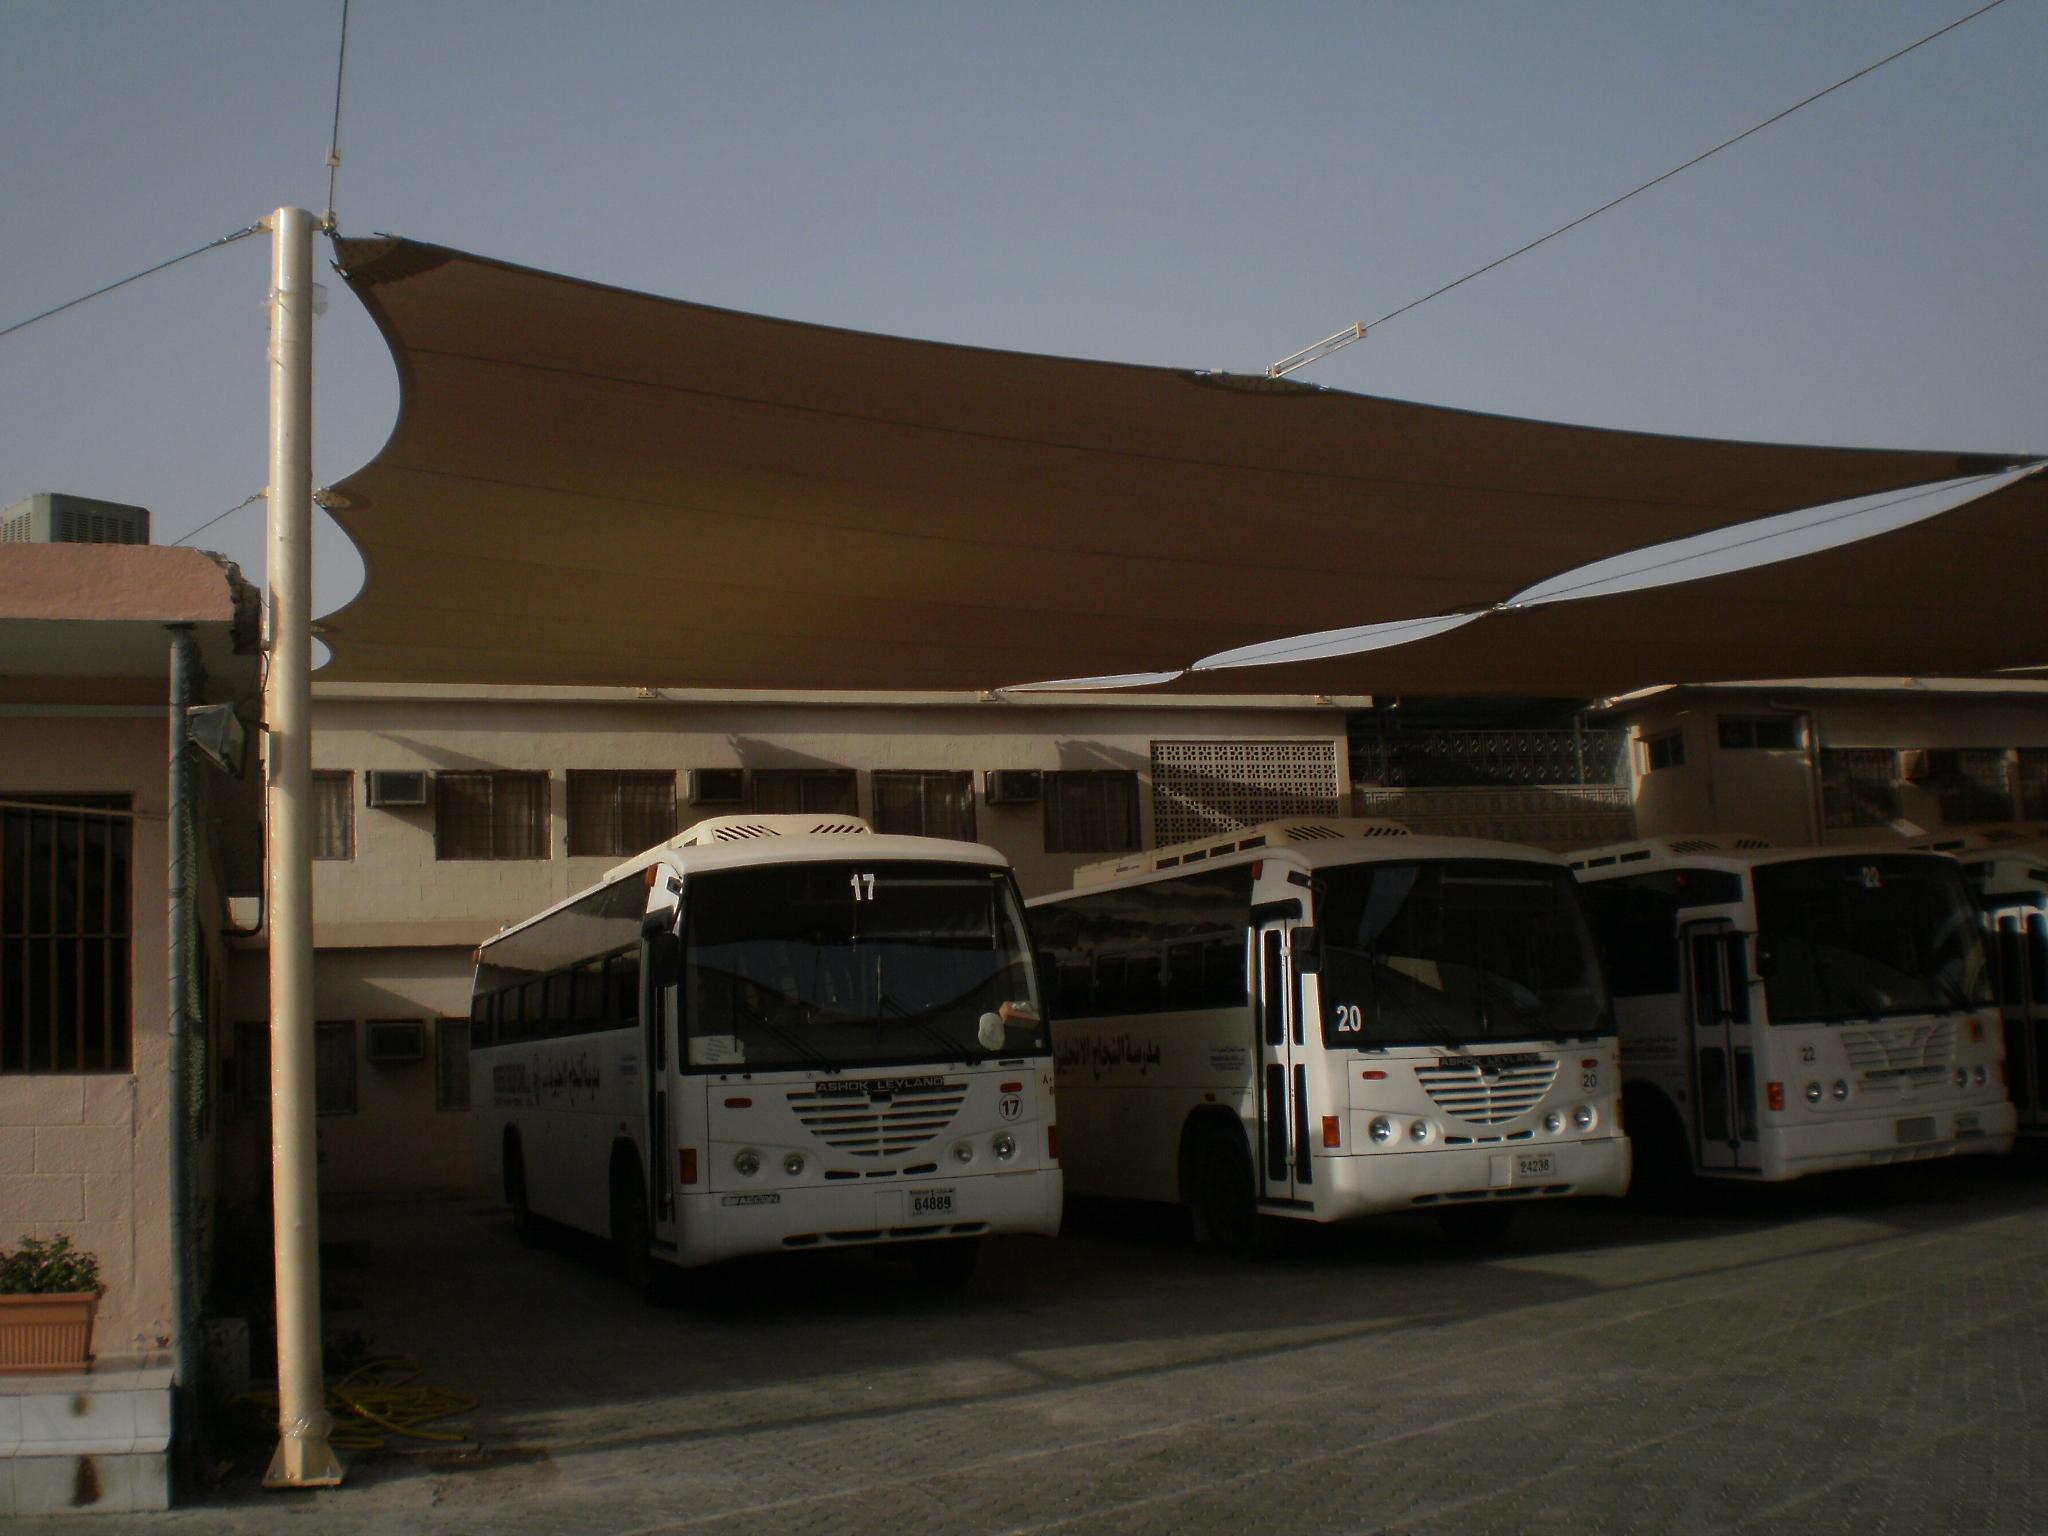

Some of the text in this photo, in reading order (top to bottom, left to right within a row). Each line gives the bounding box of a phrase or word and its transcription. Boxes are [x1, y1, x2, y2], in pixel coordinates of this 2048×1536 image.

[850, 873, 875, 901] 17
[1336, 1005, 1362, 1032] 20
[817, 1077, 944, 1092] ASHOK LEYLAND
[1583, 1073, 1597, 1088] 20
[1002, 1100, 1019, 1116] 17
[1519, 1159, 1549, 1174] 24238
[914, 1196, 951, 1212] 64889
